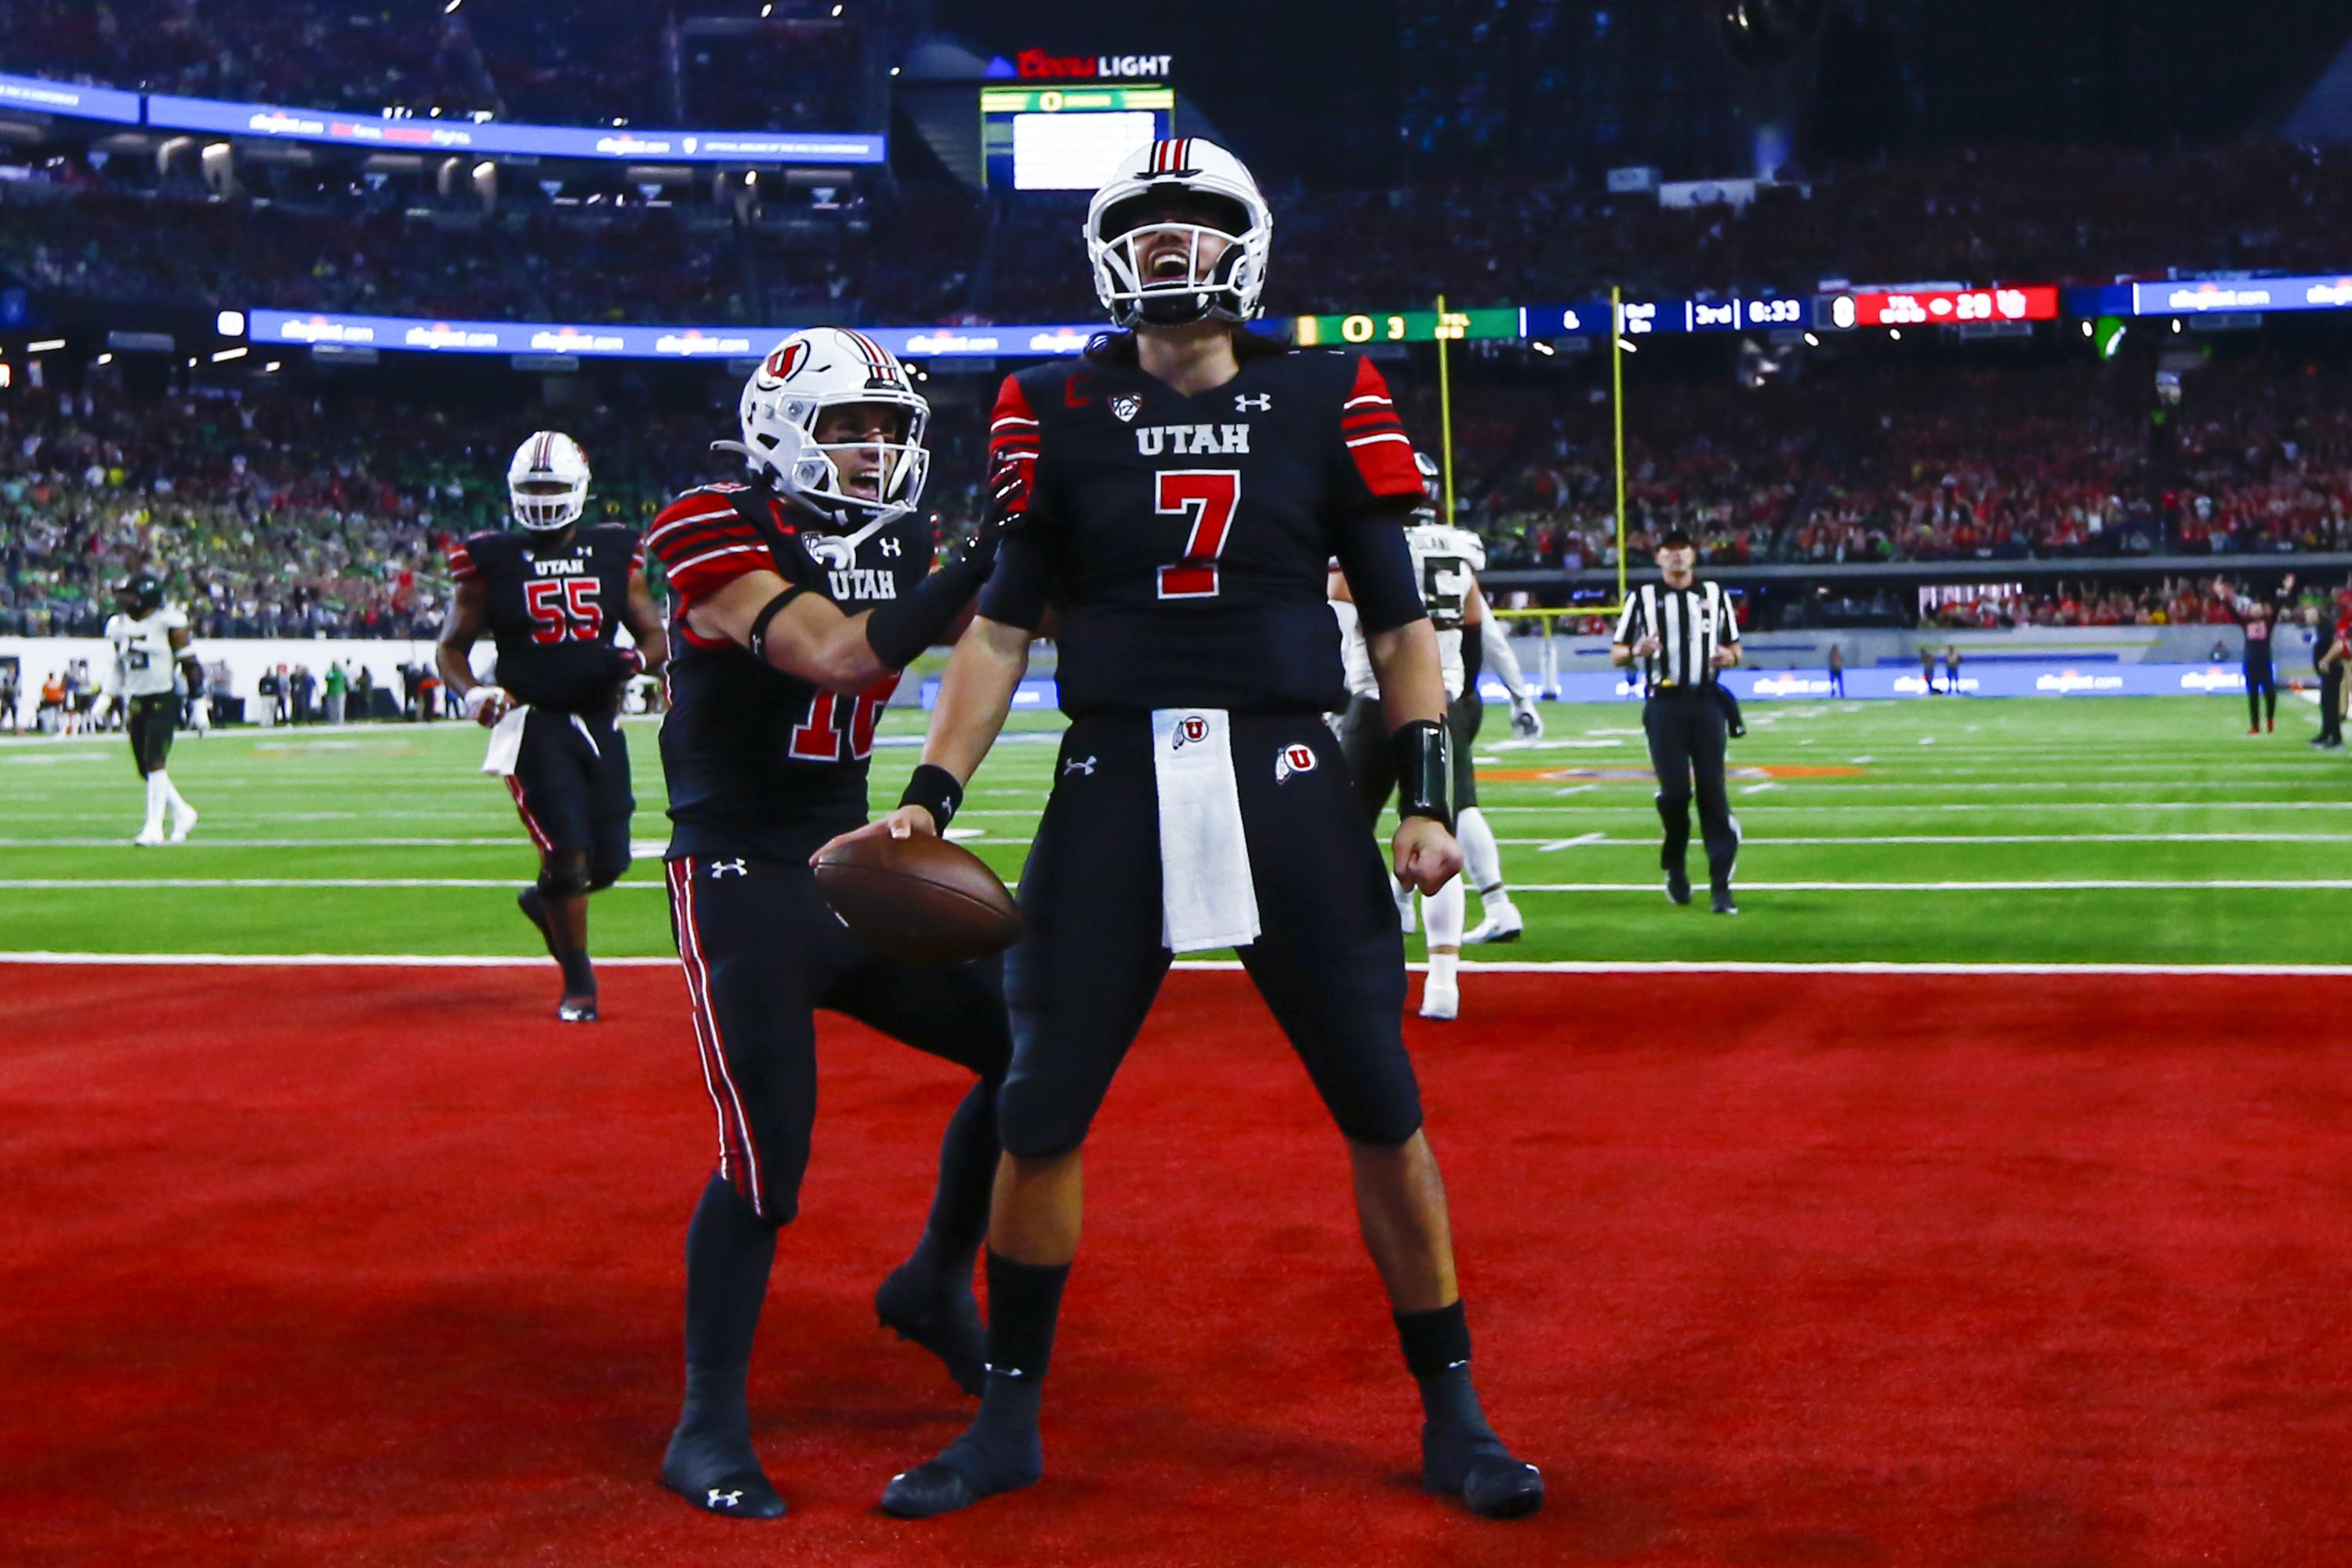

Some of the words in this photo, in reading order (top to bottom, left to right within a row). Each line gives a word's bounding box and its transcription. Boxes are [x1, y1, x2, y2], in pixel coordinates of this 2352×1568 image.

[1098, 55, 1172, 77] LIGHT
[1696, 305, 1731, 325] 3rd
[1388, 316, 1405, 339] 3
[767, 343, 801, 379] U
[1136, 423, 1250, 456] UTAH
[1155, 470, 1241, 600] 7
[535, 559, 584, 576] UTAH
[828, 569, 897, 601] UTAH
[524, 577, 603, 644] 55
[1182, 721, 1203, 739] U
[1288, 748, 1312, 768] U
